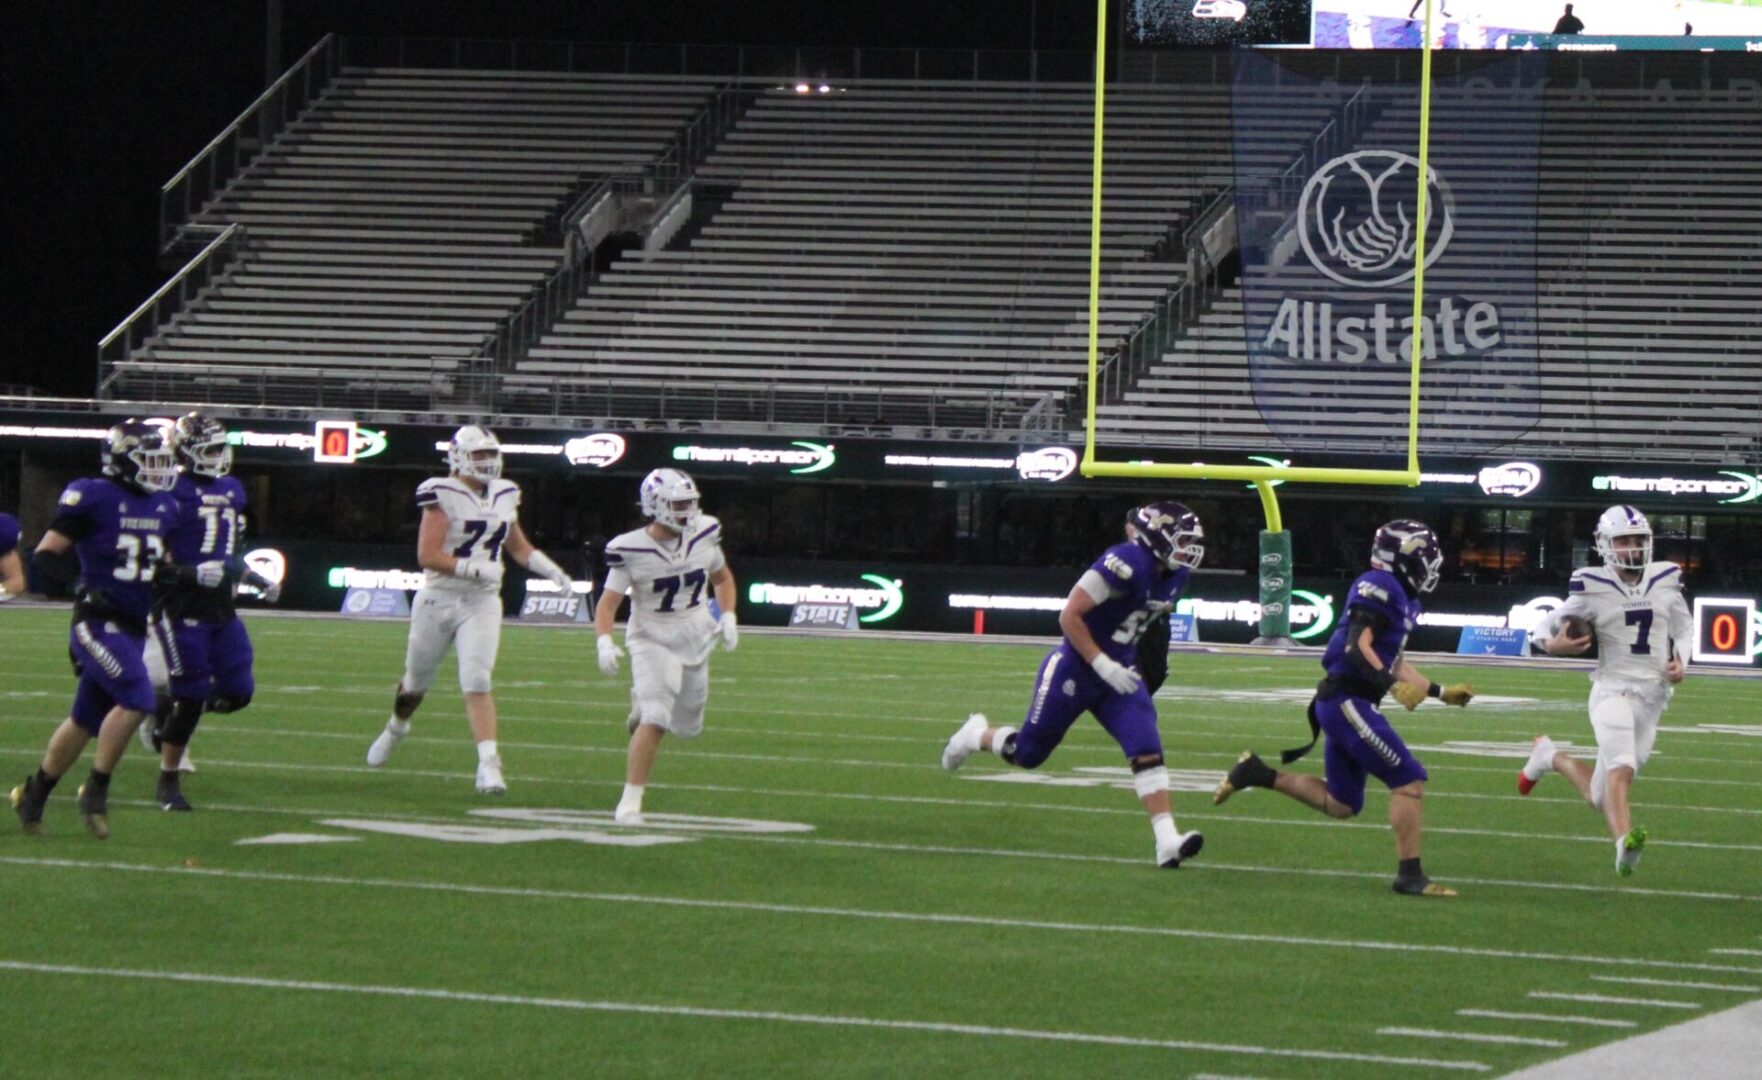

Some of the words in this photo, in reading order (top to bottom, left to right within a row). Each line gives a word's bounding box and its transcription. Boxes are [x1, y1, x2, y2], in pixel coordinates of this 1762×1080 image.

[1263, 298, 1500, 364] Allstate
[327, 431, 346, 455] 0
[112, 533, 165, 582] 33
[523, 596, 580, 617] STATE
[652, 568, 707, 613] 77
[793, 604, 849, 624] STATE
[1473, 627, 1516, 637] VICTORY
[1625, 609, 1653, 655] 7
[1712, 614, 1738, 650] 0
